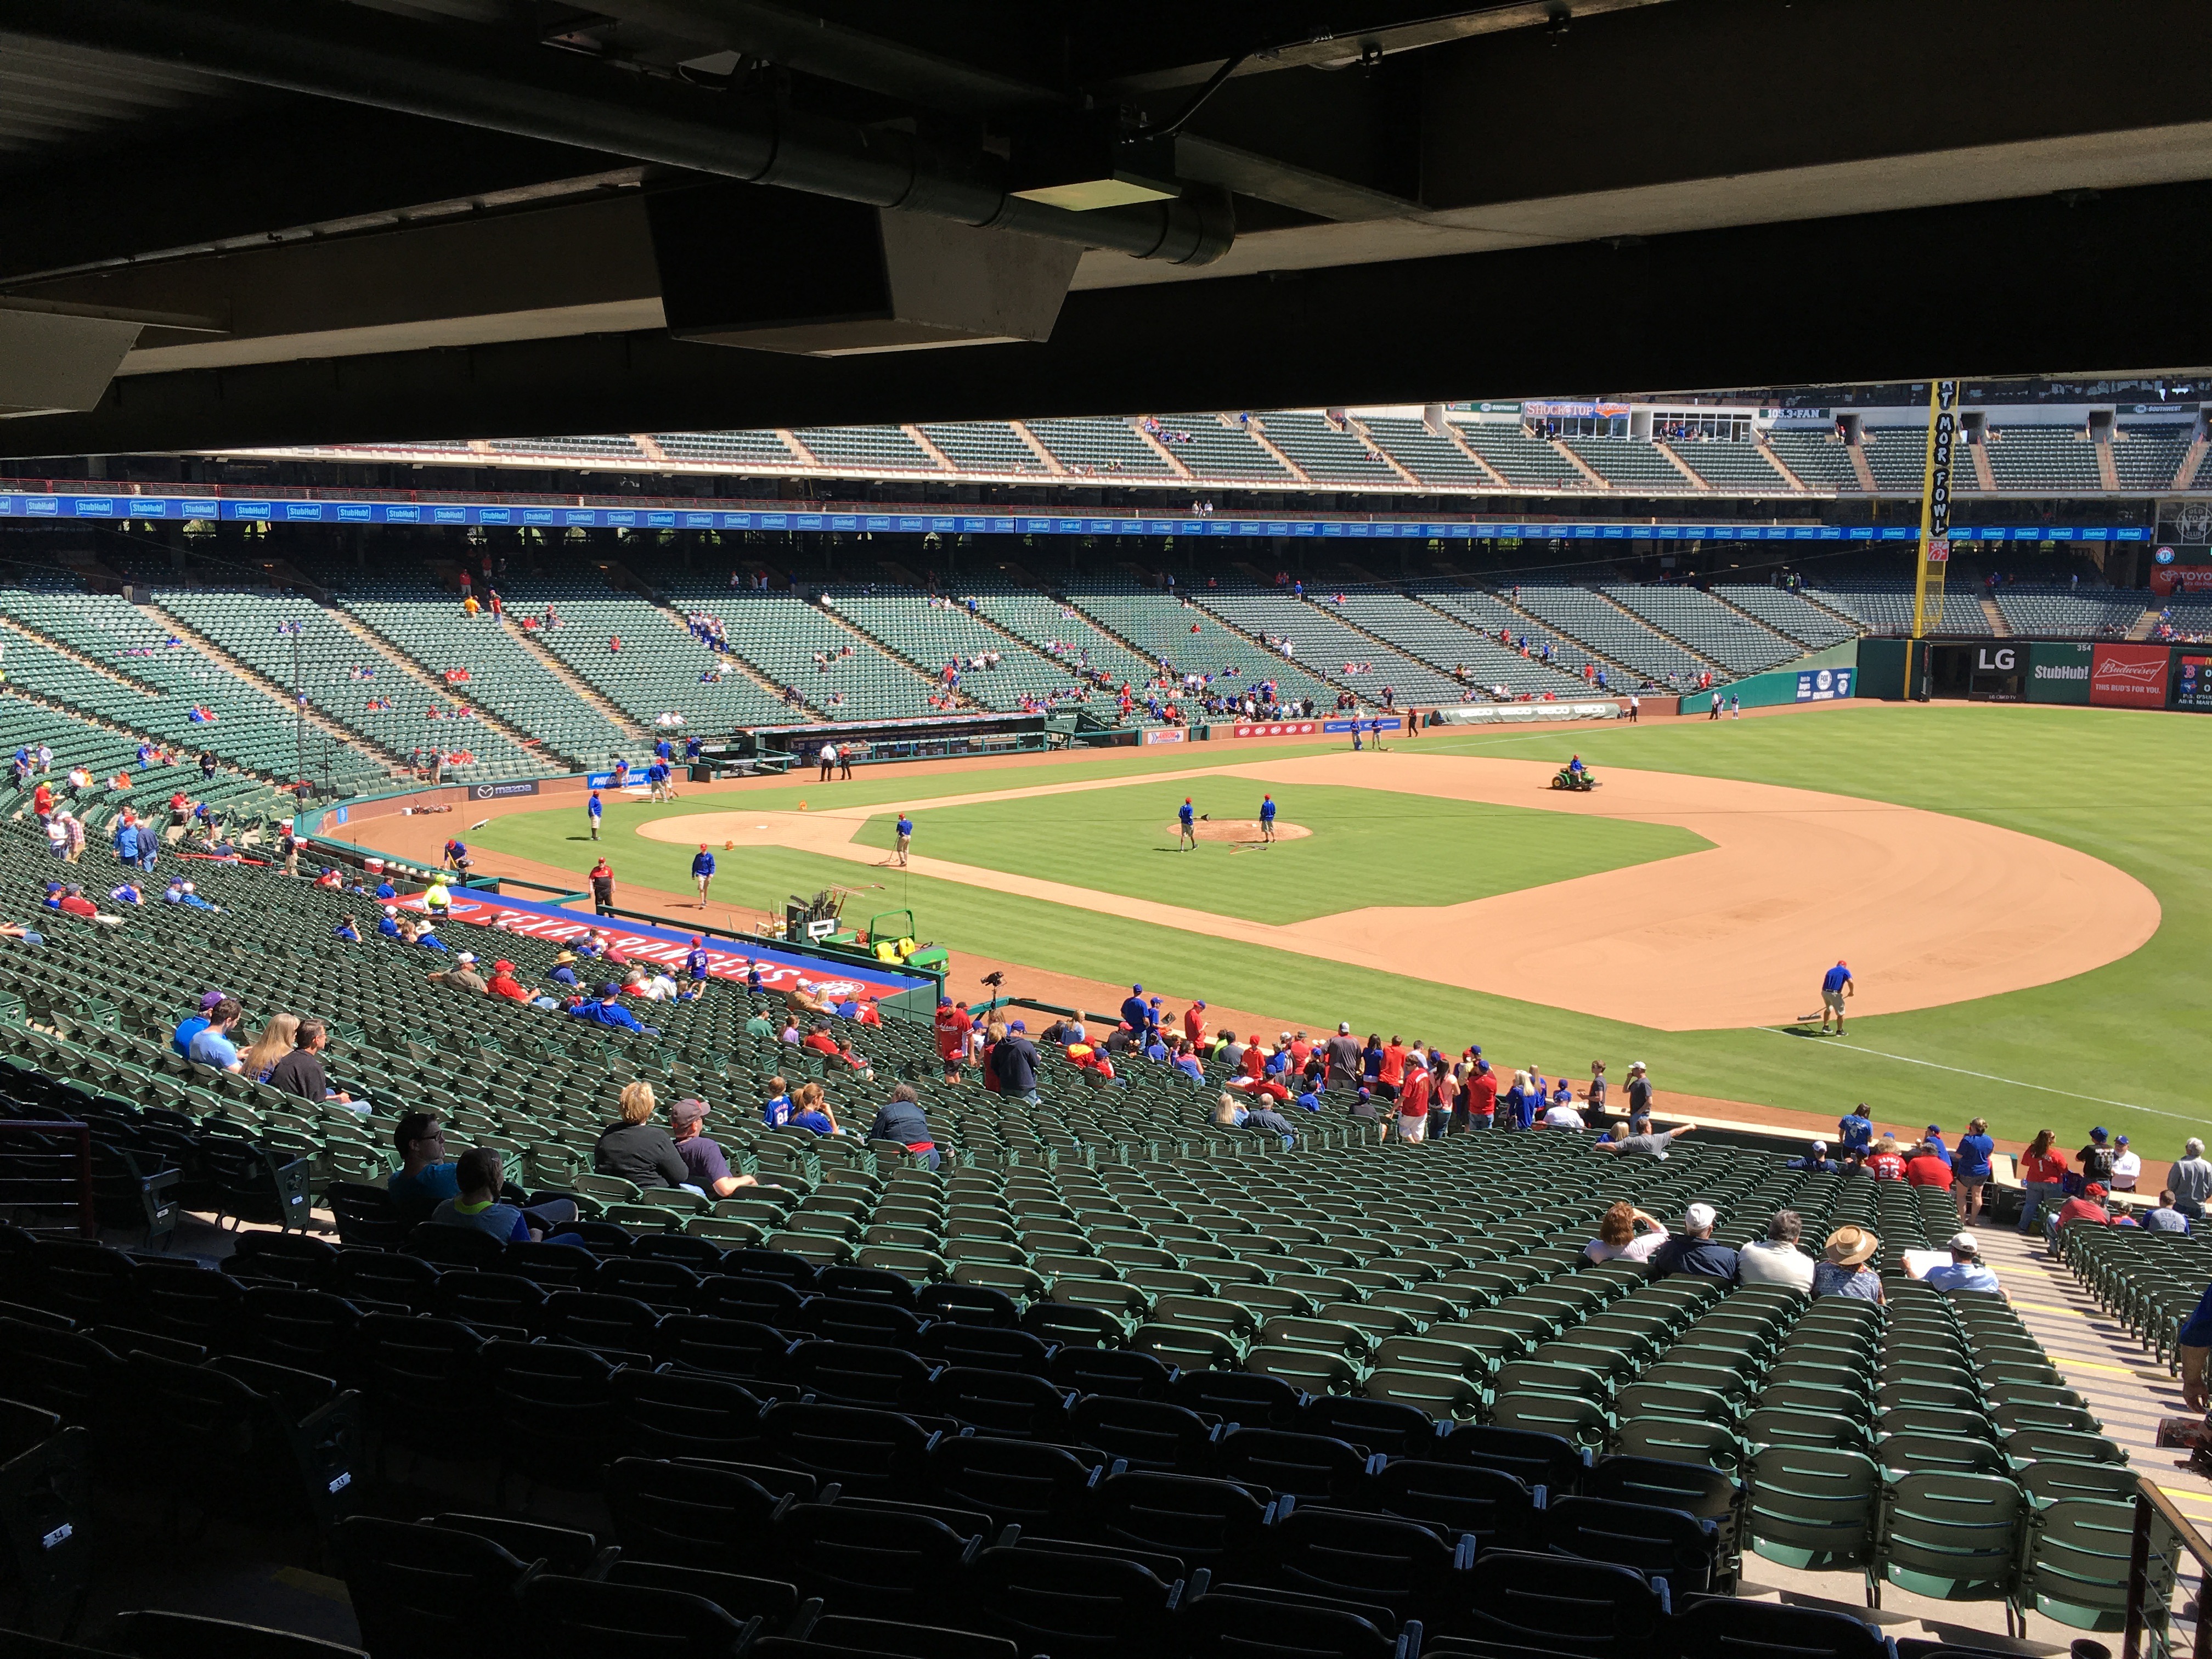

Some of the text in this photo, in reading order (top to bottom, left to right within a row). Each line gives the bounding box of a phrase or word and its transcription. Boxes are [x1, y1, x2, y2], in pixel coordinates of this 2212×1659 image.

[1527, 404, 1593, 416] SHOCK TOP
[1768, 409, 1819, 418] 105.3 FAN
[1939, 416, 1951, 462] MOR
[29, 502, 55, 512] StubHub!
[78, 502, 110, 512] StubHub!
[1934, 472, 1946, 533] FOWL
[133, 504, 163, 513] StubHub!
[184, 505, 213, 514] StubHub!
[238, 506, 268, 515] StubHub!
[290, 507, 319, 516] StubHub!
[340, 509, 368, 517] StubHub!
[389, 510, 417, 518] StubHub!
[437, 511, 462, 519] StubHub!
[482, 512, 508, 520] StubHub!
[2180, 572, 2212, 580] TOYO
[1979, 648, 2015, 670] LG
[2034, 665, 2089, 679] StubHub!
[2101, 663, 2157, 675] Budweiser
[1813, 691, 1834, 699] SOUTHWEST
[592, 773, 646, 786] PROGRESIVE
[495, 785, 532, 794] mazda
[696, 957, 706, 967] 29
[2038, 1160, 2043, 1172] 1
[1879, 1165, 1899, 1178] 25
[2161, 1220, 2177, 1231] 34
[337, 1477, 345, 1488] 33
[53, 1530, 63, 1542] 34
